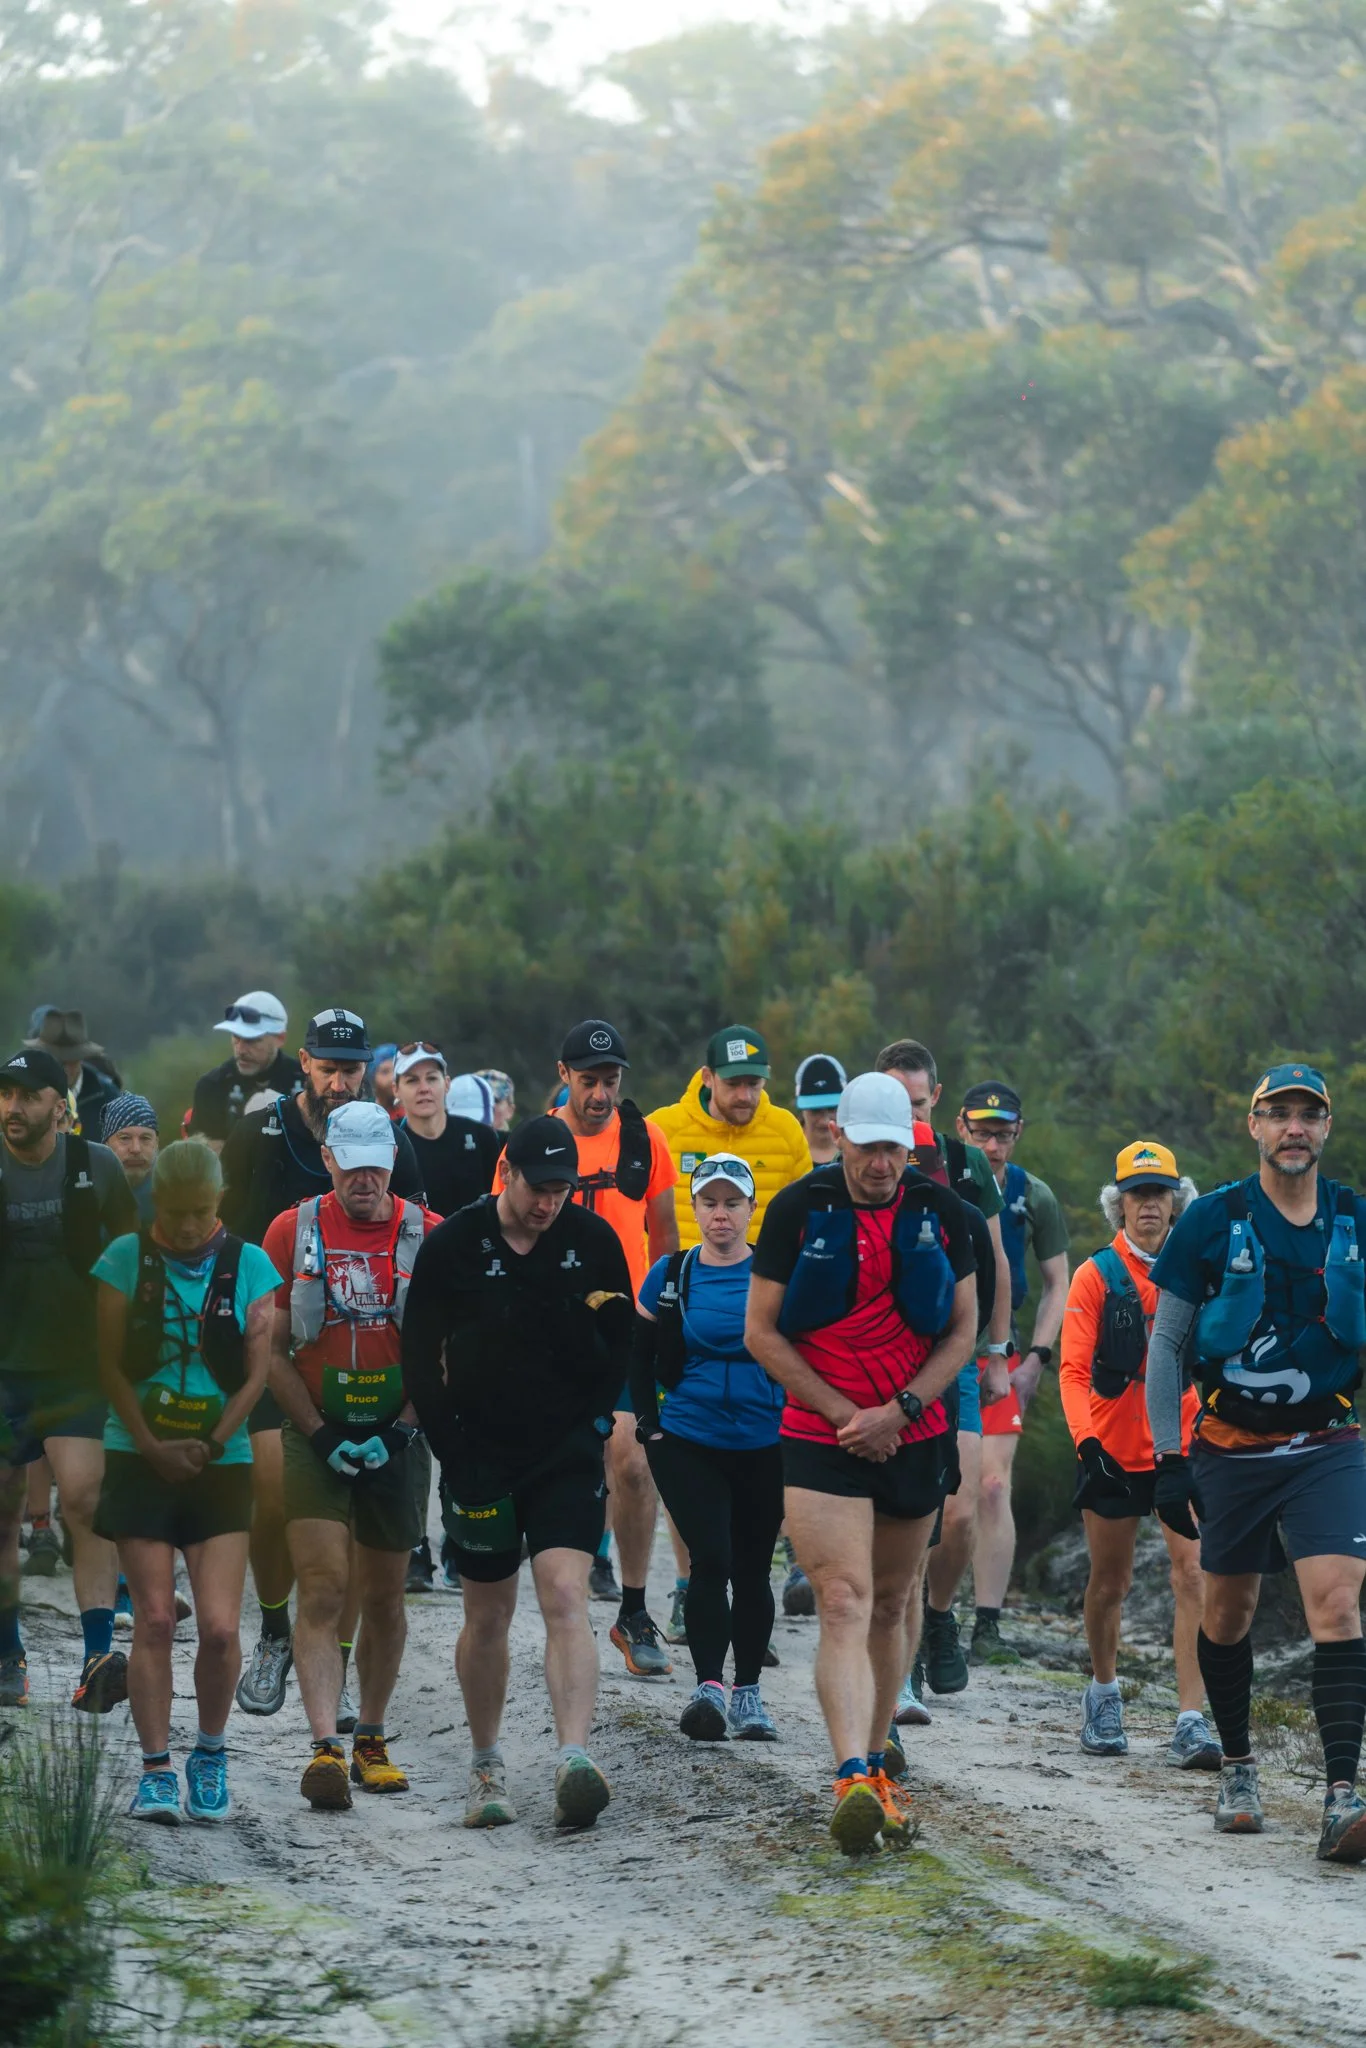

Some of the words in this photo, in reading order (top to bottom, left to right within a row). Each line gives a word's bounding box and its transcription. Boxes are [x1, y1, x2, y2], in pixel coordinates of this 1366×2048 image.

[357, 1373, 386, 1384] 2024
[345, 1393, 379, 1403] Bruce
[178, 1399, 208, 1411] 2024
[467, 1508, 498, 1519] 2024
